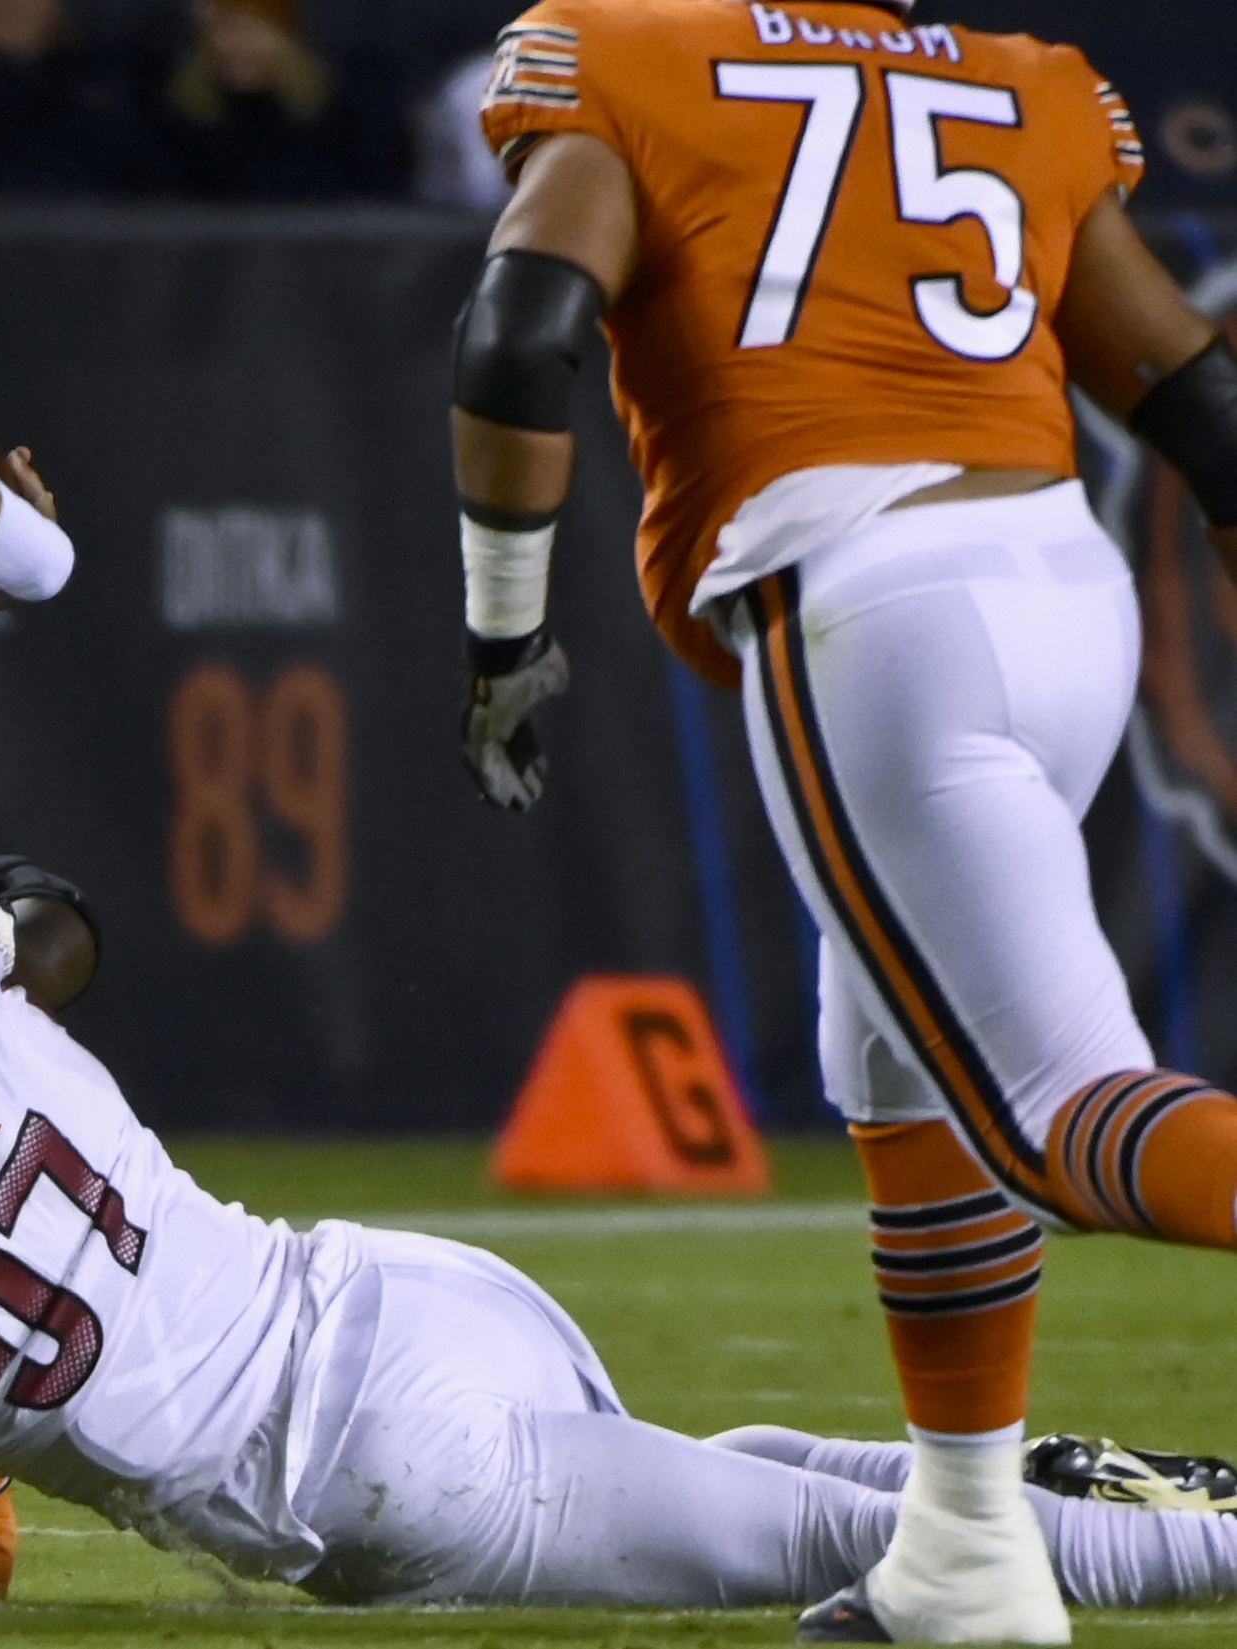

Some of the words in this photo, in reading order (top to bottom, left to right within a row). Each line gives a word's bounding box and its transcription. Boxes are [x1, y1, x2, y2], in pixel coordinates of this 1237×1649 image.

[711, 57, 1038, 363] 75
[170, 662, 350, 945] 89
[624, 1009, 737, 1168] G
